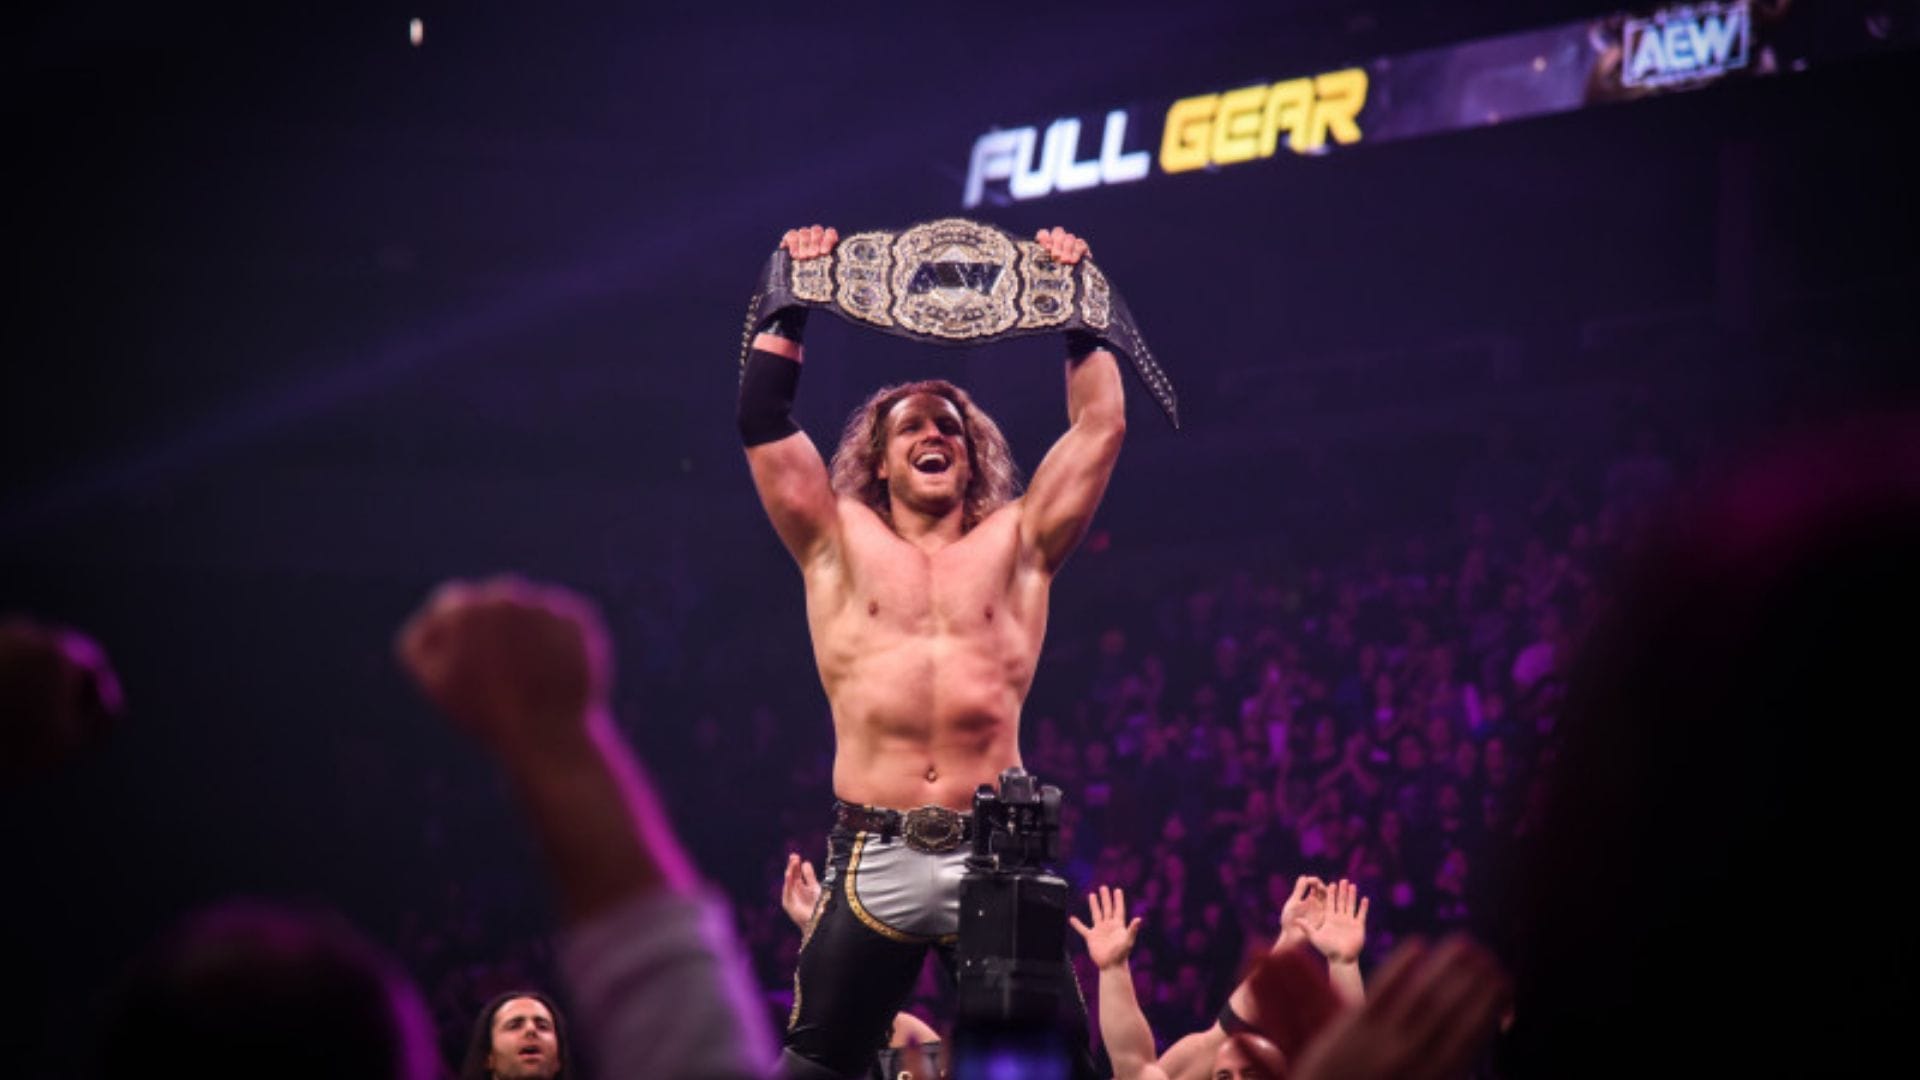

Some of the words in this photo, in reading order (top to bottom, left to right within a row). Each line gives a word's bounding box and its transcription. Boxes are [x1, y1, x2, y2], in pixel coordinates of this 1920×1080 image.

[1630, 9, 1742, 81] AEW
[963, 109, 1150, 208] FULL
[1159, 67, 1368, 174] GEAR
[907, 261, 1005, 296] AW
